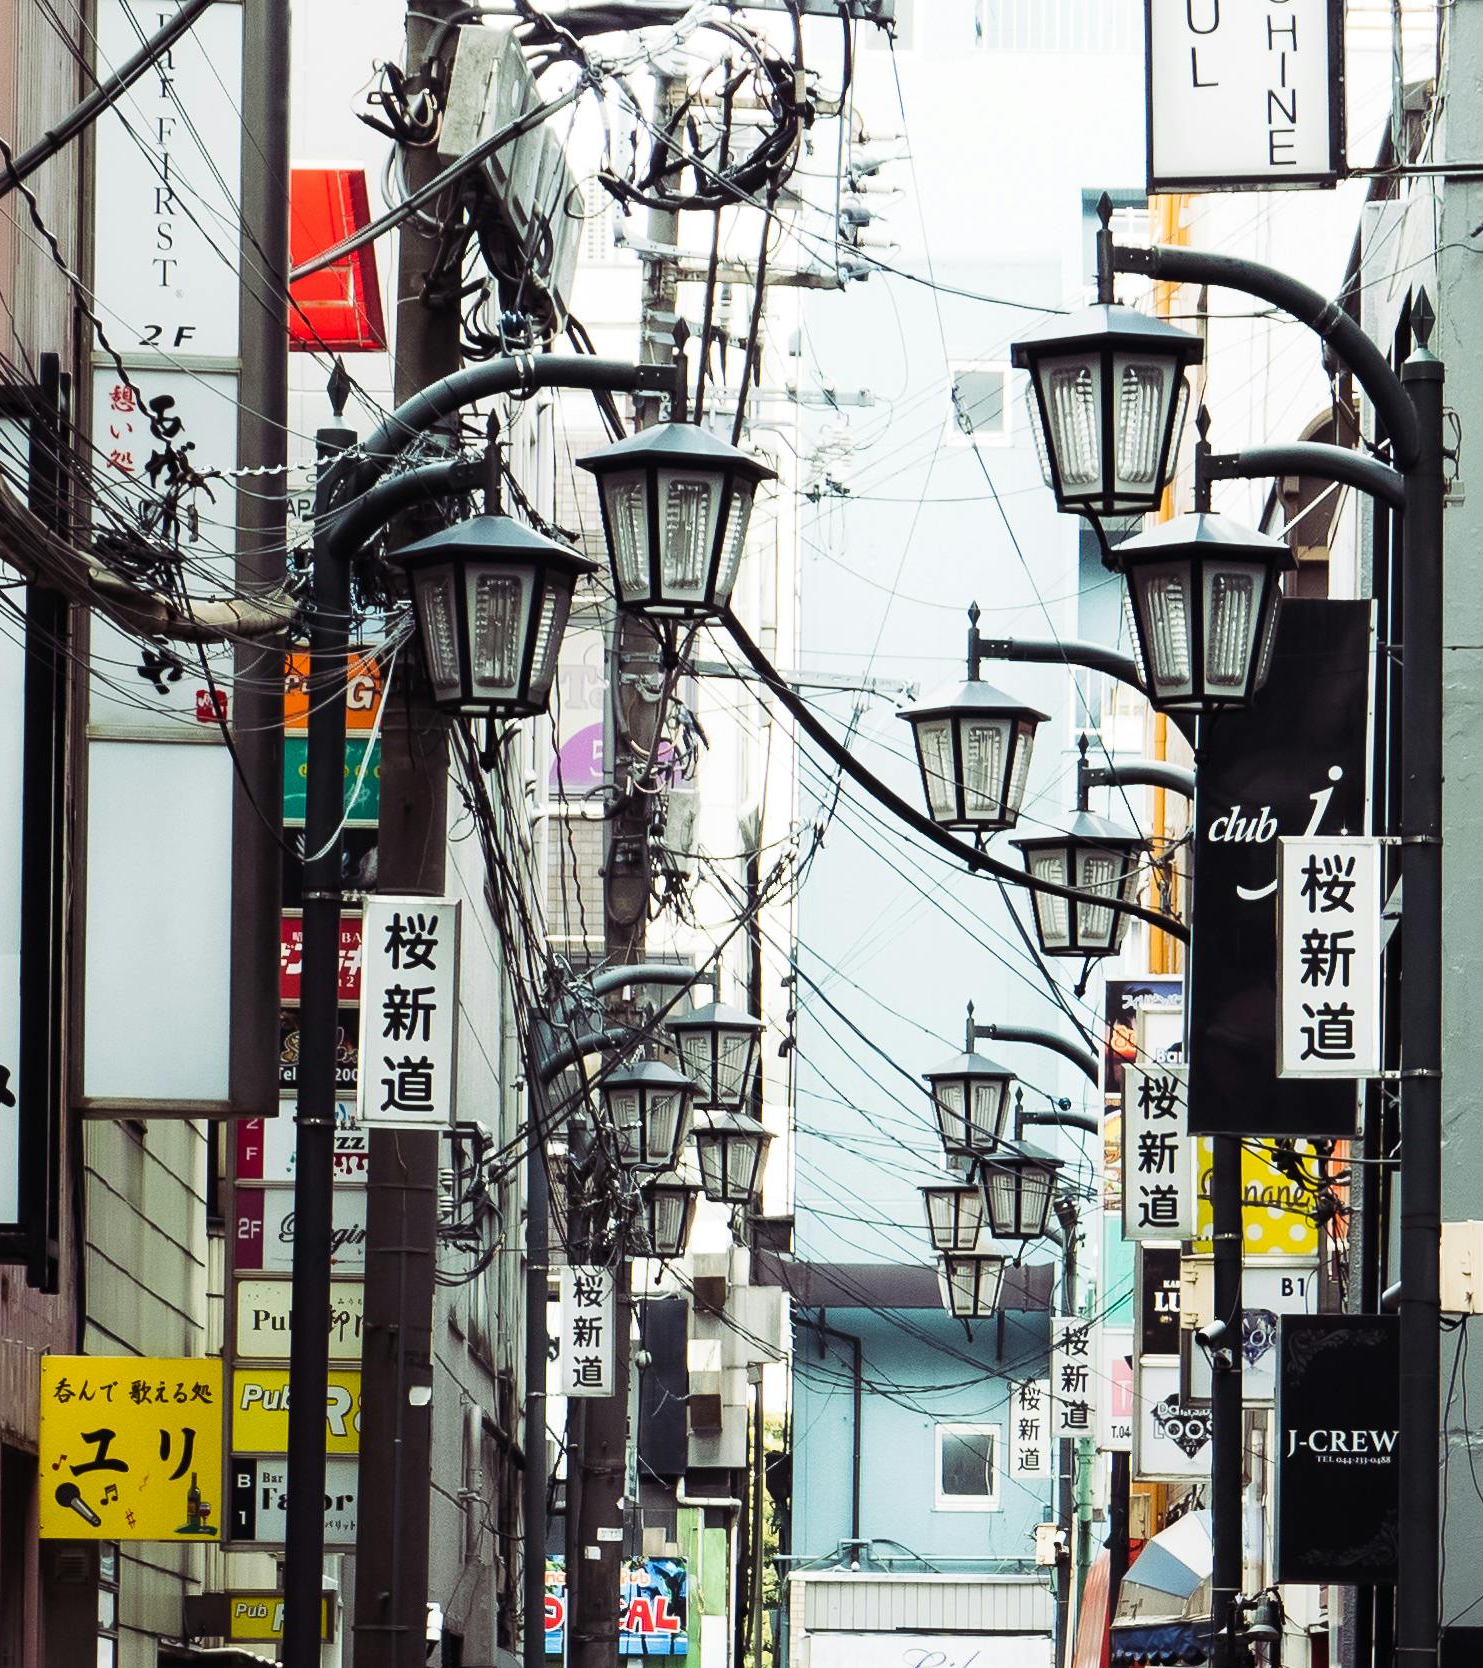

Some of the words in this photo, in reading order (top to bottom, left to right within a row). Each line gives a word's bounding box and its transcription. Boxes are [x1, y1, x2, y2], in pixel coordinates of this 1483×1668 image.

[1267, 0, 1297, 166] HINE
[152, 117, 178, 287] FIRST
[107, 384, 136, 473] 憩い処
[1207, 806, 1277, 844] club
[1300, 854, 1357, 1061] 桜新道
[380, 912, 438, 1113] 桜新道
[1137, 1076, 1179, 1229] 桜新道
[237, 1217, 262, 1240] 2F
[1281, 1278, 1305, 1297] B1
[572, 1275, 604, 1389] 桜新道
[53, 1378, 119, 1404] 呑んで
[128, 1379, 214, 1405] 歌える処
[1060, 1326, 1090, 1429] 桜新道
[69, 1427, 197, 1481] ユリ
[1018, 1384, 1042, 1472] 桜新道
[1286, 1429, 1400, 1459] J-CREW
[262, 1471, 284, 1484] Bar
[235, 1603, 268, 1618] Pub
